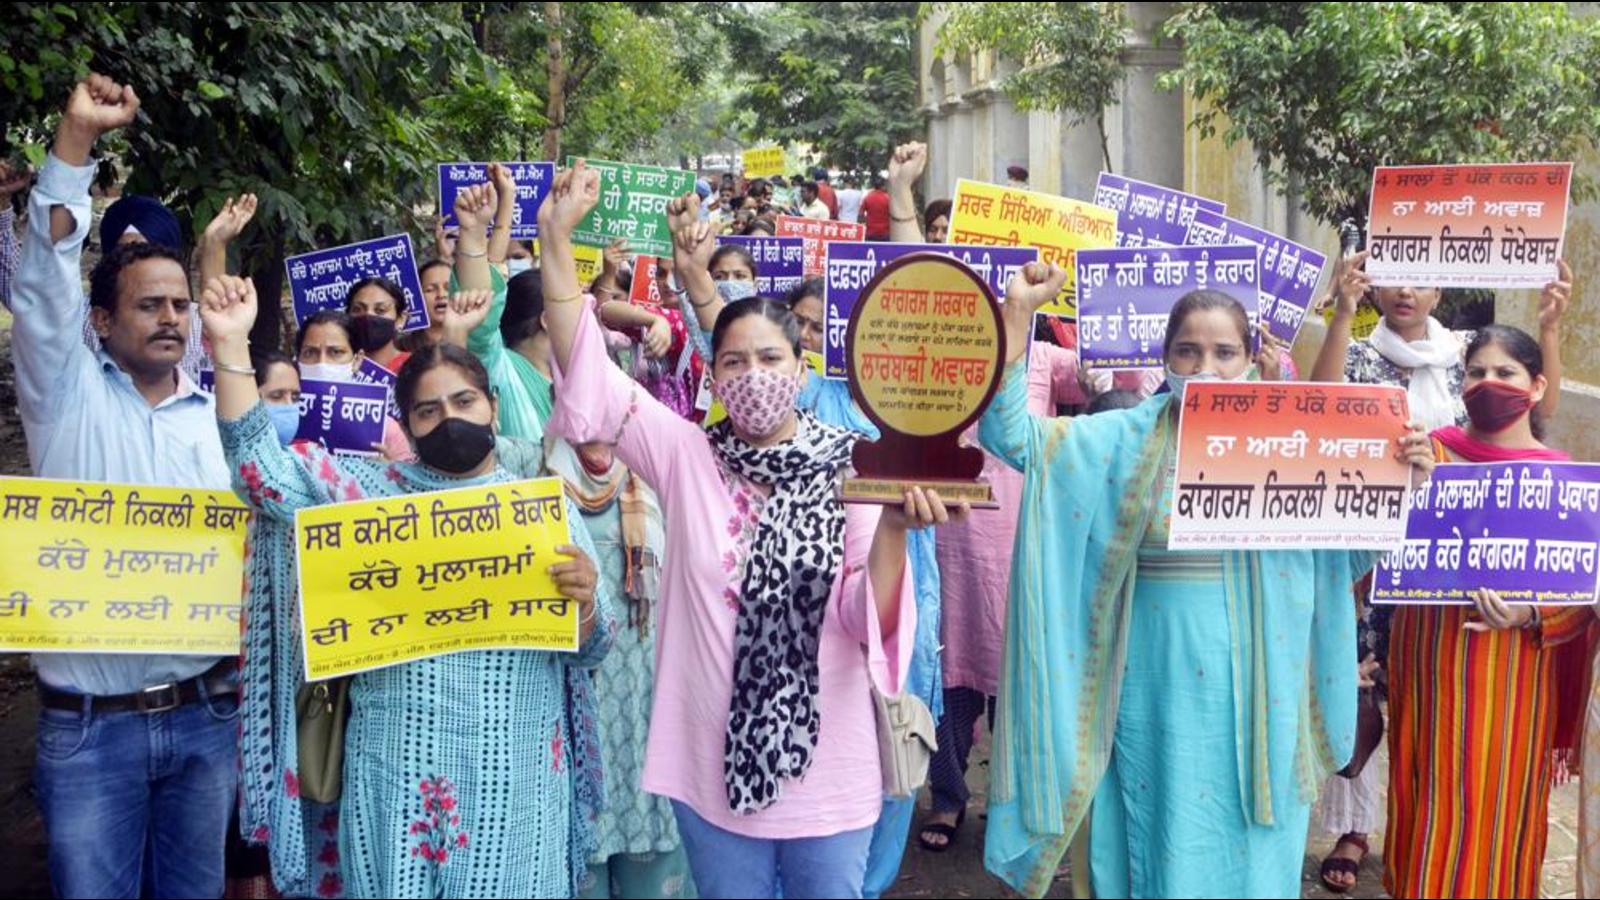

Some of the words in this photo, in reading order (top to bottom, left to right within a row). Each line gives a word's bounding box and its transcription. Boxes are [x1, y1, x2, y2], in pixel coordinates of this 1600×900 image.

[604, 184, 622, 211] ਹੀ
[1376, 175, 1388, 187] 4
[957, 193, 994, 219] ਸਰਵ
[1058, 206, 1114, 243] ਅਭਿਆਨ
[1392, 200, 1417, 216] ਨਾ
[1424, 195, 1476, 216] ਆਈ
[1371, 227, 1433, 264] ਕਾਂਗਰਸ
[1439, 224, 1494, 265] ਨਿਕਲੀ
[1080, 263, 1110, 299] ਪੂਰਾ
[1115, 253, 1148, 288] ਨਹੀਂ
[1153, 252, 1190, 285] ਕੀਤਾ
[1214, 259, 1256, 285] ਕਰਾਰ
[880, 281, 929, 313] ਕਾਂਗਰਸ
[933, 290, 978, 318] ਸਰਕਾਰ
[1081, 315, 1102, 349] ਹੁਣ
[1107, 306, 1123, 341] ਤਾਂ
[931, 353, 990, 387] ਅਵਾਰਡ
[321, 385, 338, 431] ਤੂੰ
[342, 396, 384, 423] ਕਰਾਰ
[1185, 392, 1201, 412] 4
[1212, 389, 1258, 414] ਸਾਲਾਂ
[1266, 387, 1287, 414] ਤੋਂ
[1336, 396, 1381, 417] ਕਰਨ
[1389, 391, 1409, 418] ਦੀ
[1206, 435, 1236, 457] ਨਾ
[1247, 429, 1309, 458] ਆਈ
[1318, 437, 1388, 460] ਅਵਾਜ਼
[3, 494, 41, 521] ਸਬ
[50, 488, 116, 526] ਕਮੇਟੀ
[123, 491, 194, 529] ਨਿਕਲੀ
[1178, 472, 1254, 519] ਕਾਂਗਰਸ
[1262, 470, 1327, 519] ਨਿਕਲੀ
[1435, 471, 1491, 518] ਮੁਲਾਜ਼ਮਾਂ
[1496, 467, 1514, 509] ਦੀ
[1518, 467, 1553, 510] ਇਹੀ
[1558, 481, 1599, 520] ਪੁਕਾਰ
[304, 522, 342, 551] ਸਬ
[354, 503, 419, 546] ਕਮੇਟੀ
[430, 492, 501, 539] ਨਿਕਲੀ
[511, 490, 562, 527] ਬੇਕਾਰ
[38, 538, 90, 571] ਕੱਚੇ
[103, 546, 219, 578] ਮੁਲਾਜ਼ਮਾਂ
[349, 559, 401, 592] ਕੱਚੇ
[417, 544, 535, 592] ਮੁਲਾਜ਼ਮਾਂ
[1436, 526, 1463, 570] ਕਰੇ
[1467, 527, 1529, 571] ਕਾਂਗਰਸ
[1534, 540, 1597, 574] ਸਰਕਾਰ
[49, 598, 90, 619] ਨਾ
[105, 595, 173, 621] ਲਈ
[310, 618, 352, 646] ਦੀ
[369, 613, 408, 636] ਨਾ
[425, 598, 492, 627] ਲਈ
[509, 598, 571, 618] ਸਾਰ
